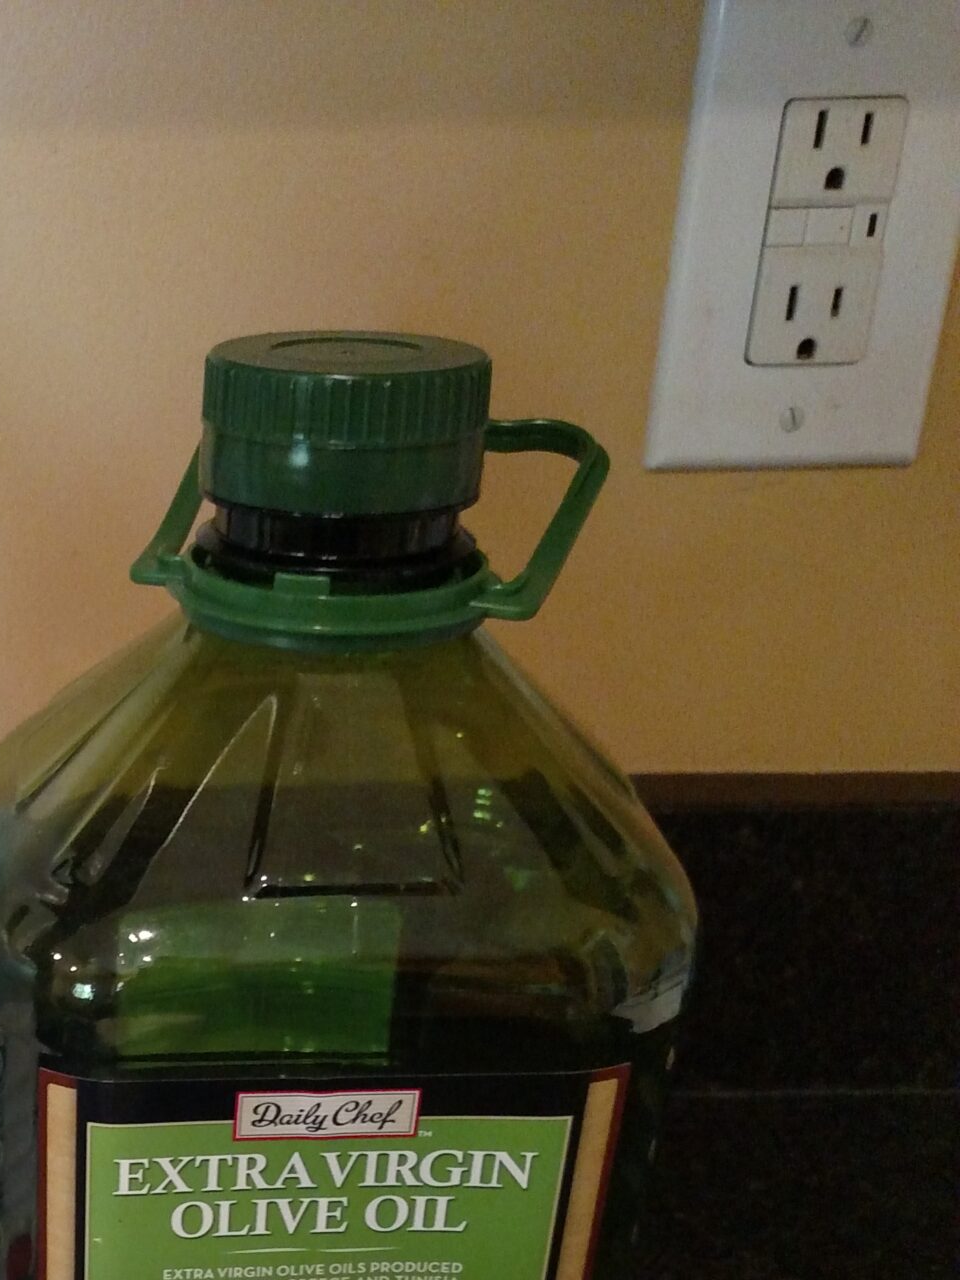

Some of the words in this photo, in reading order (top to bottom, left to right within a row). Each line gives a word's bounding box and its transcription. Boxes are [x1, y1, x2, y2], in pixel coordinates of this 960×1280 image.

[251, 1102, 328, 1133] Daily
[332, 1099, 403, 1130] Chef
[112, 1151, 318, 1197] EXTRA
[320, 1149, 539, 1190] VIRGIN
[170, 1196, 348, 1239] OLIVE
[364, 1195, 468, 1234] OIL
[163, 1268, 214, 1280] EXTRA
[217, 1266, 273, 1279] VIRGIN
[276, 1264, 325, 1277] OLIVE
[329, 1262, 366, 1275] OILS
[370, 1261, 463, 1274] PRODUCED
